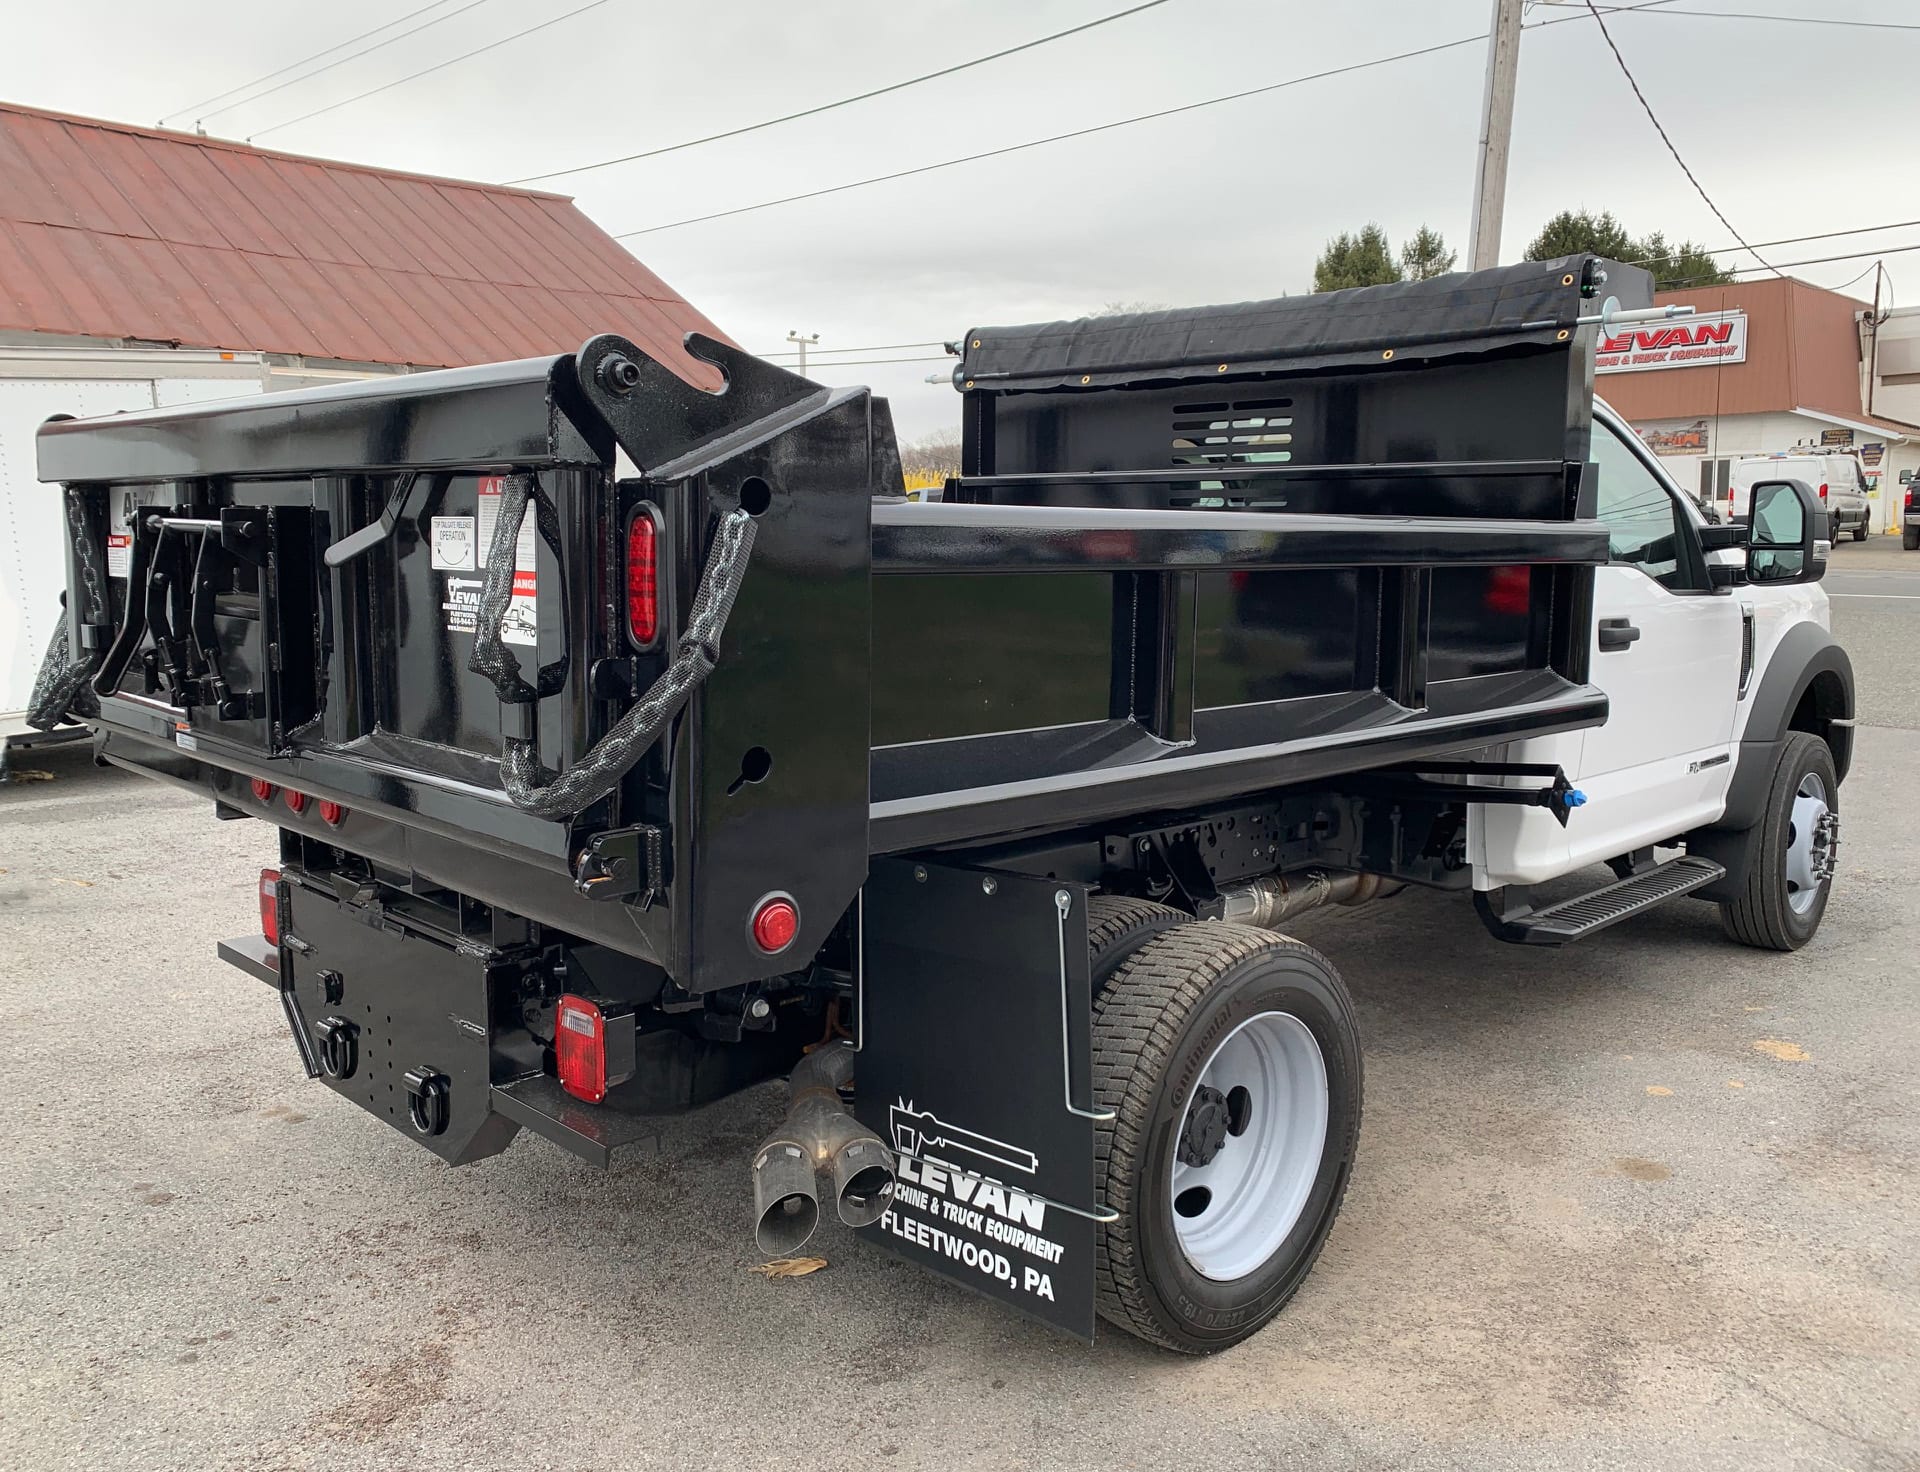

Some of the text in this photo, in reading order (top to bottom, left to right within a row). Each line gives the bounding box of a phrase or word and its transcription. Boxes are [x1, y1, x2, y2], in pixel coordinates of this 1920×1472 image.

[1595, 322, 1733, 353] EVAN
[1632, 353, 1667, 364] TRUCK
[1670, 345, 1737, 360] EQUIPMENT
[439, 530, 466, 541] OPERATION
[513, 579, 536, 589] DANG
[898, 1149, 1046, 1232] LEVAN
[894, 1183, 1065, 1264] CHINE & TRUCK EQUIPMENT
[880, 1208, 1056, 1302] FLEETWOOD, PA
